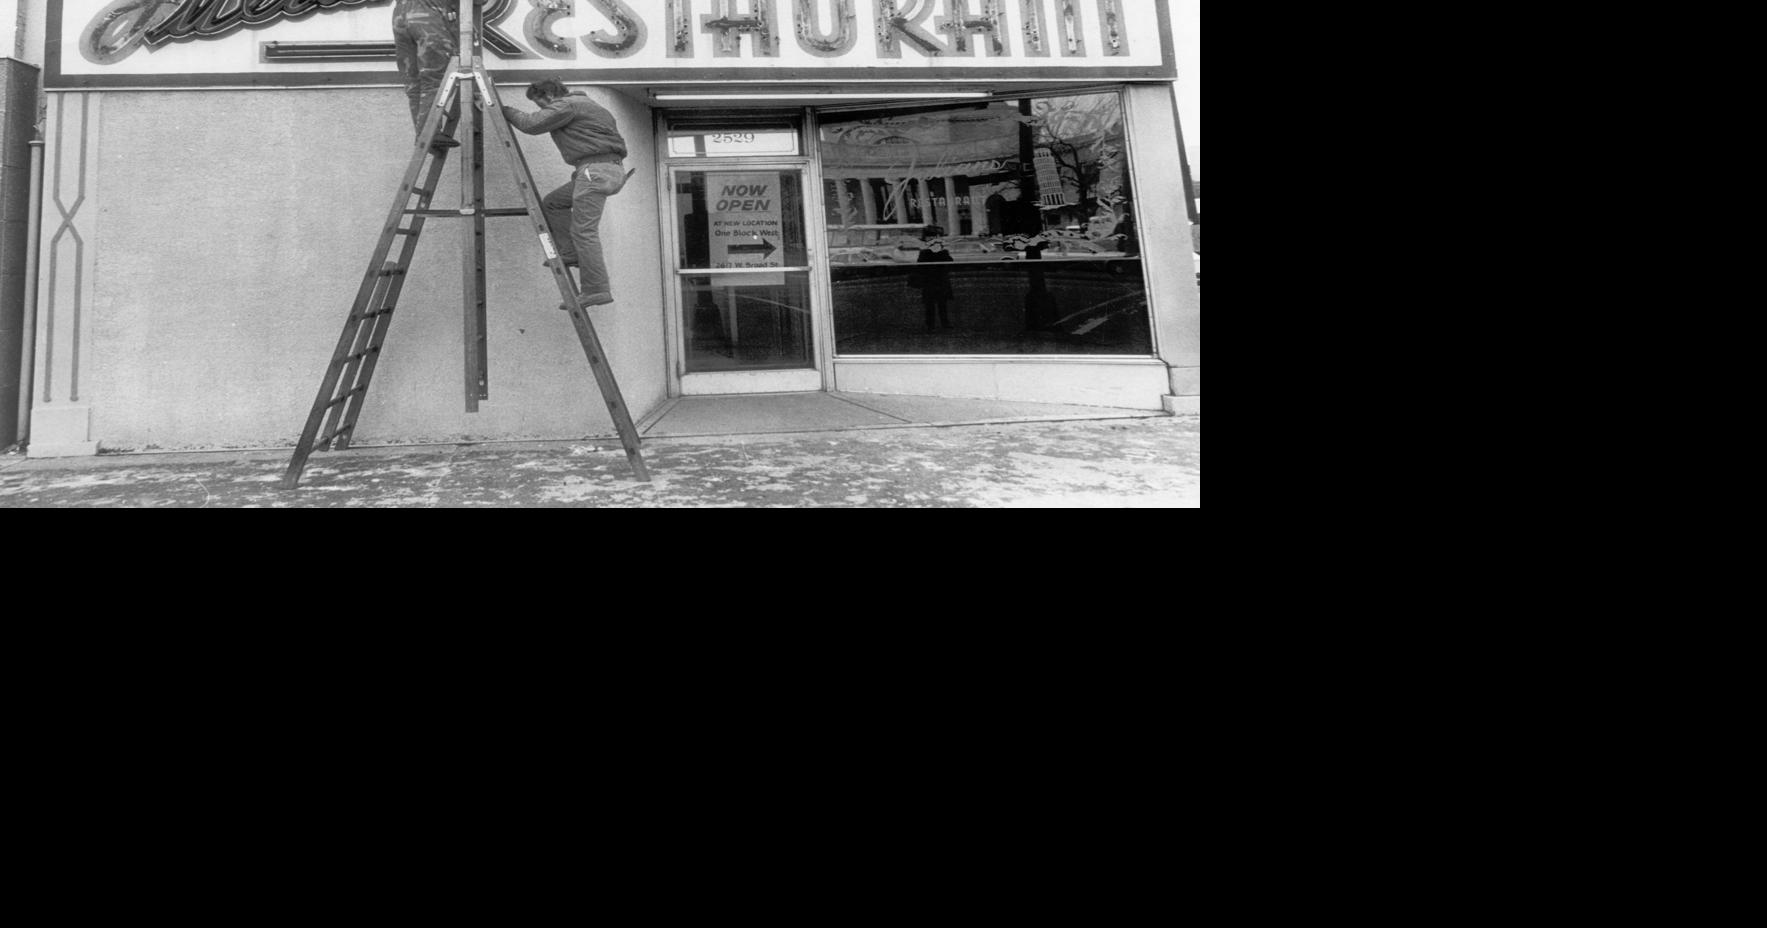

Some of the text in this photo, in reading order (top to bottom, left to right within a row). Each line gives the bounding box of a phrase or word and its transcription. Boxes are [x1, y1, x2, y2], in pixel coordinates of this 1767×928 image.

[711, 132, 755, 144] 2529
[721, 184, 768, 197] NOW
[715, 199, 771, 212] OPEN
[909, 195, 986, 209] RESTARAT
[742, 219, 778, 227] LOCATION
[714, 228, 778, 237] One Block West
